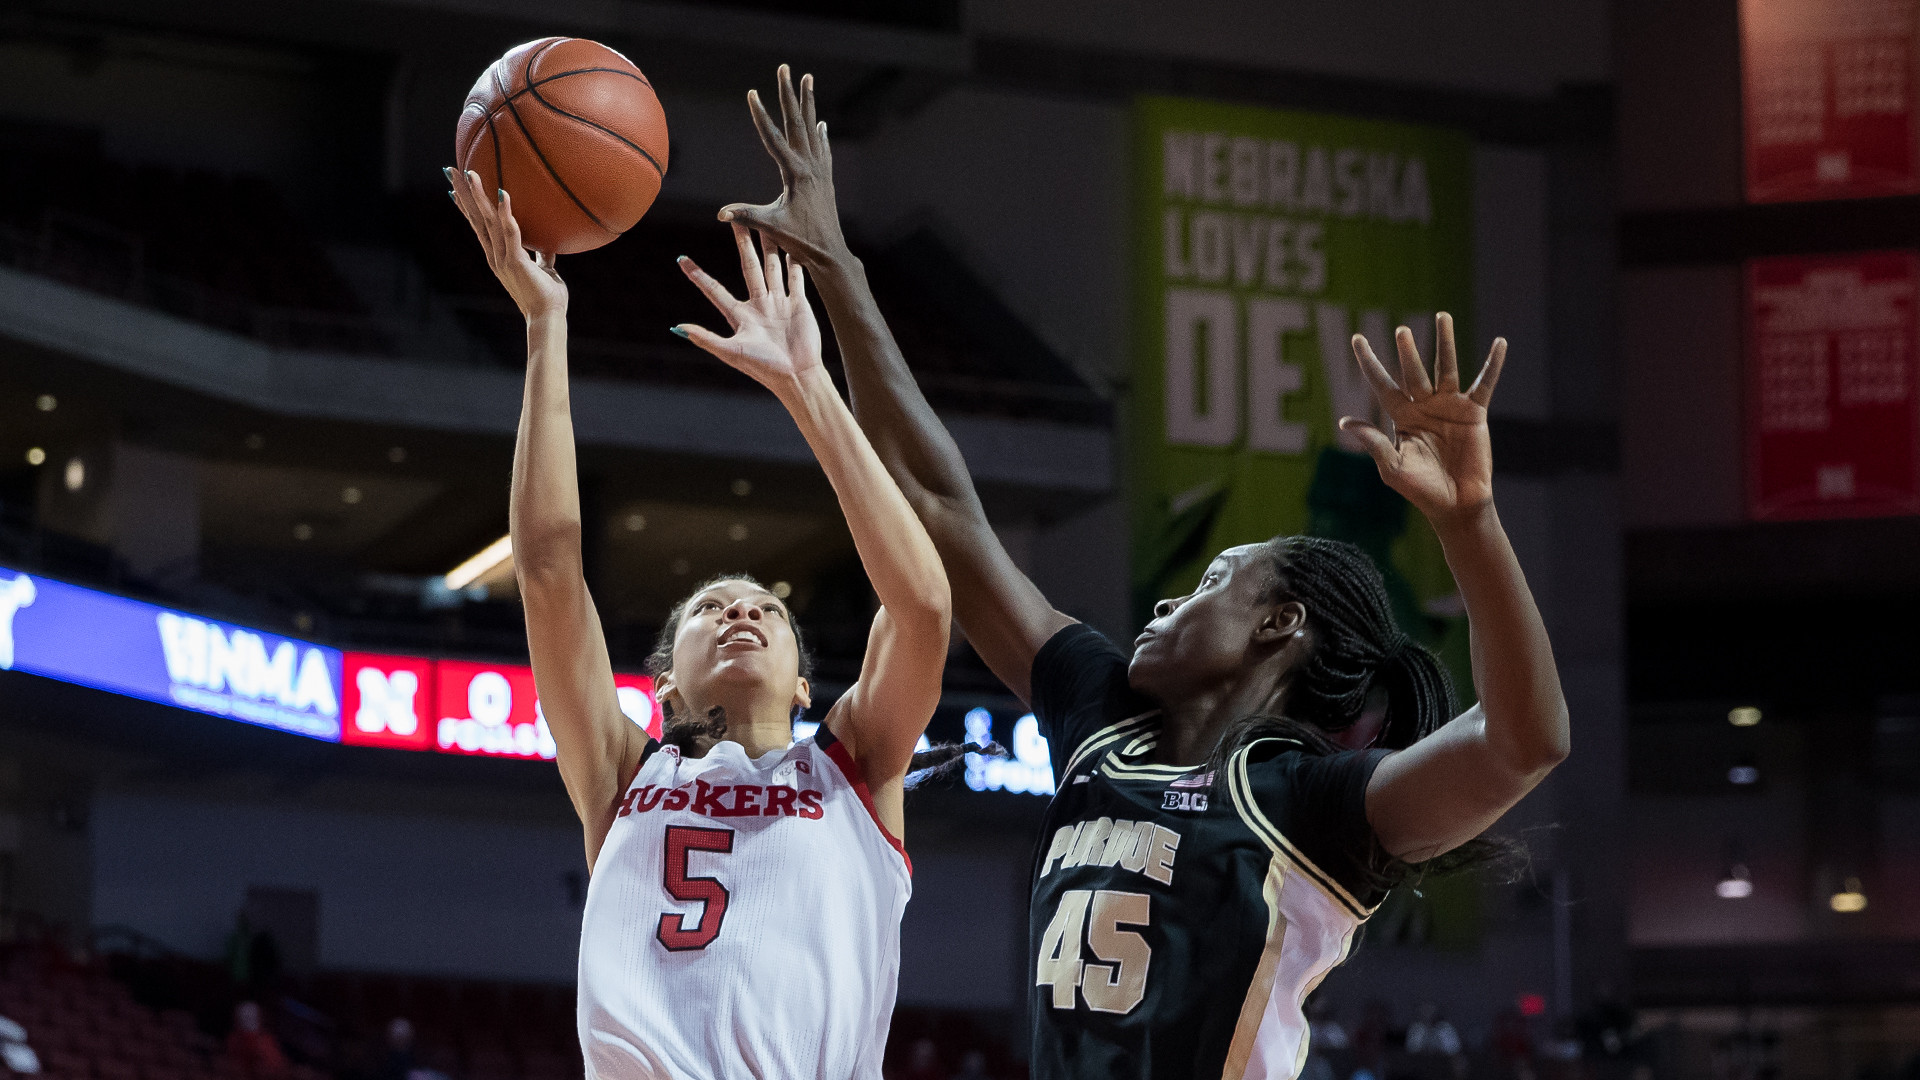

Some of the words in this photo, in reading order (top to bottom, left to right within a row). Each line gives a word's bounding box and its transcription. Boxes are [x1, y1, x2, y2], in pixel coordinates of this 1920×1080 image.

[1163, 131, 1432, 223] NEBRASKA
[1164, 210, 1328, 292] LOVES
[618, 779, 824, 821] HUSKERS
[656, 824, 735, 952] 5
[1040, 815, 1182, 886] PURDUE
[1036, 889, 1152, 1016] 45
